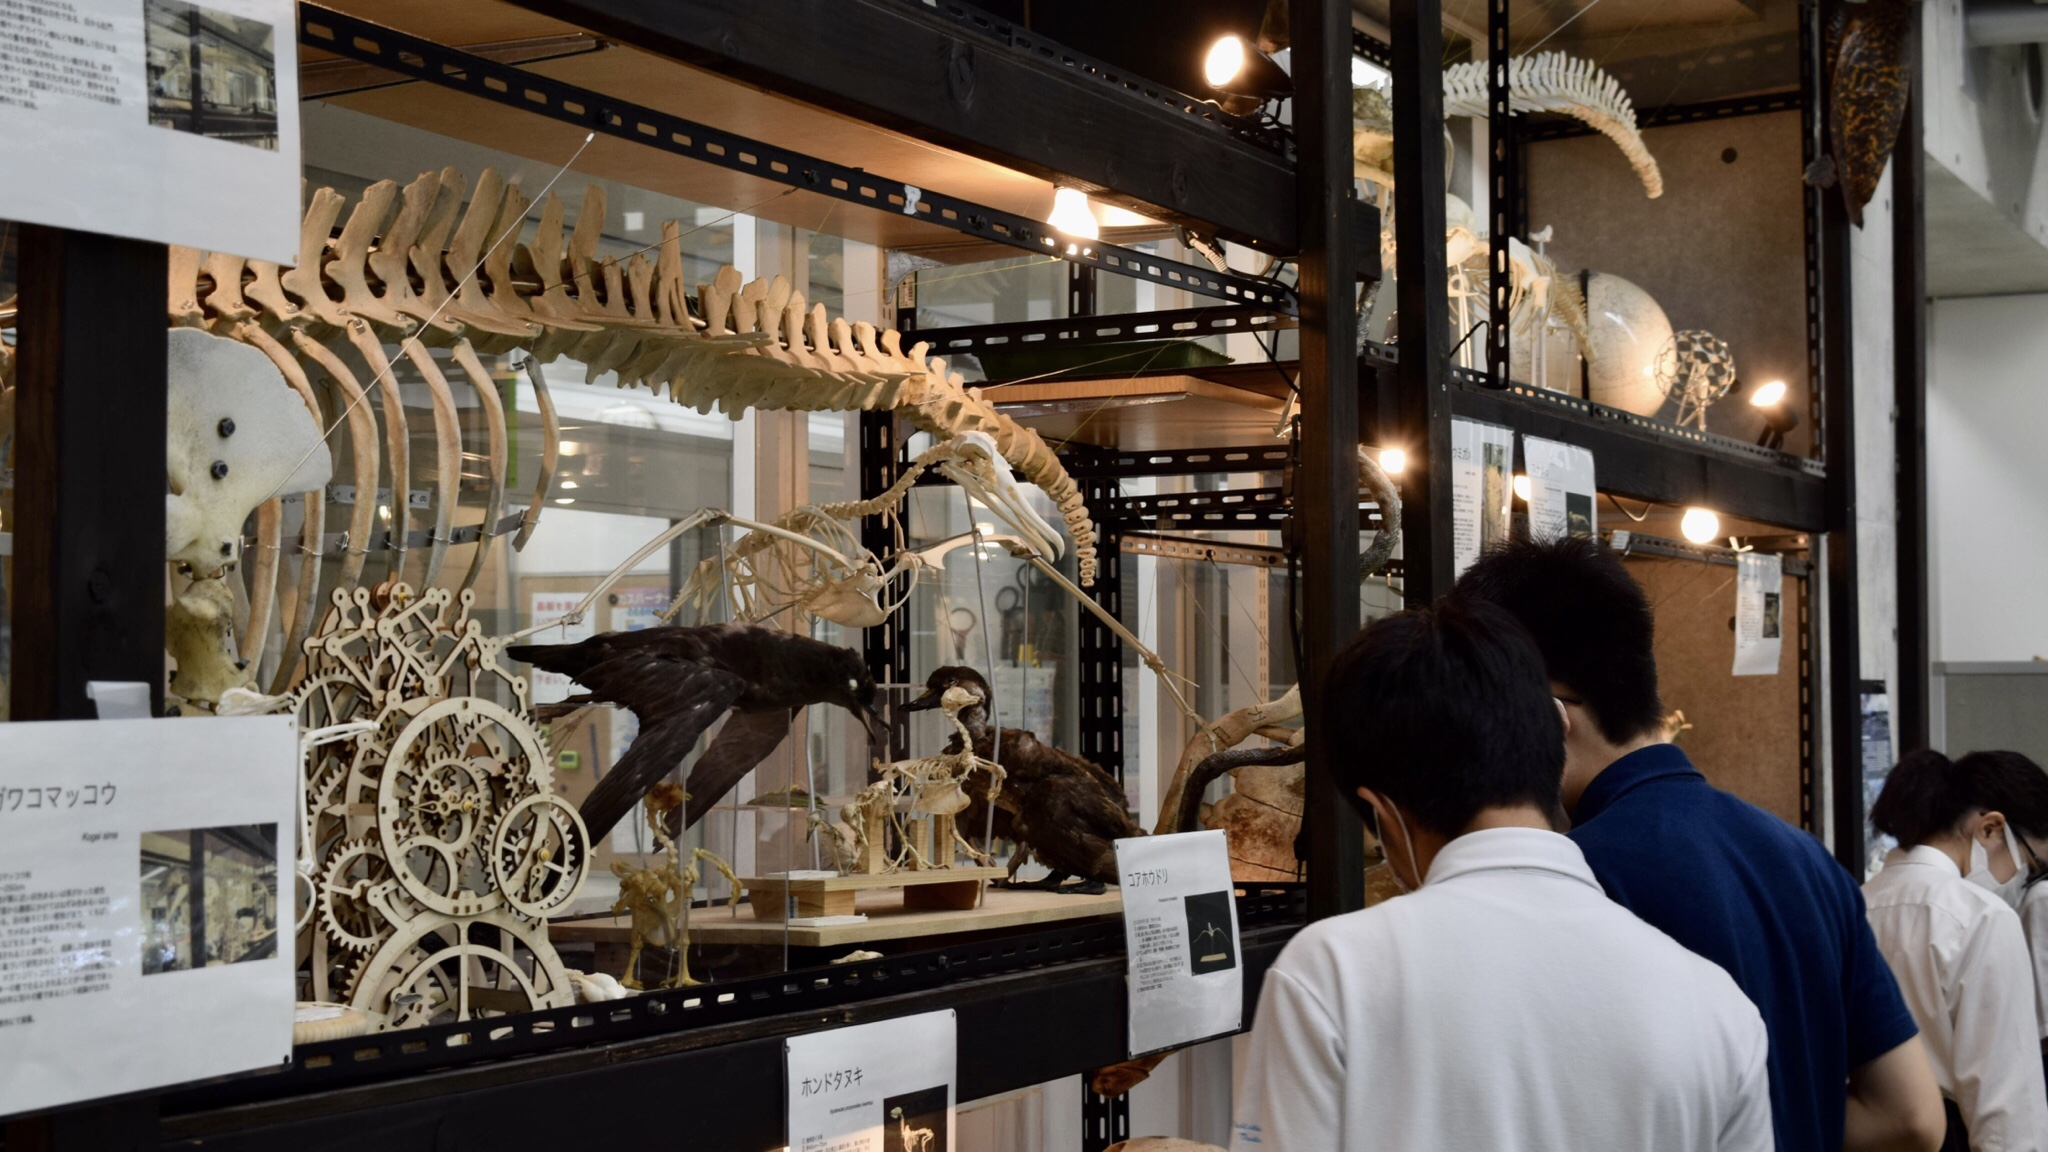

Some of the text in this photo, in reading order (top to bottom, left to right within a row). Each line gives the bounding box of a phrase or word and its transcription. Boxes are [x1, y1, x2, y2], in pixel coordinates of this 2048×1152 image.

[1128, 868, 1169, 888] コアホウドリ
[801, 1067, 864, 1097] ホンドタヌキ
